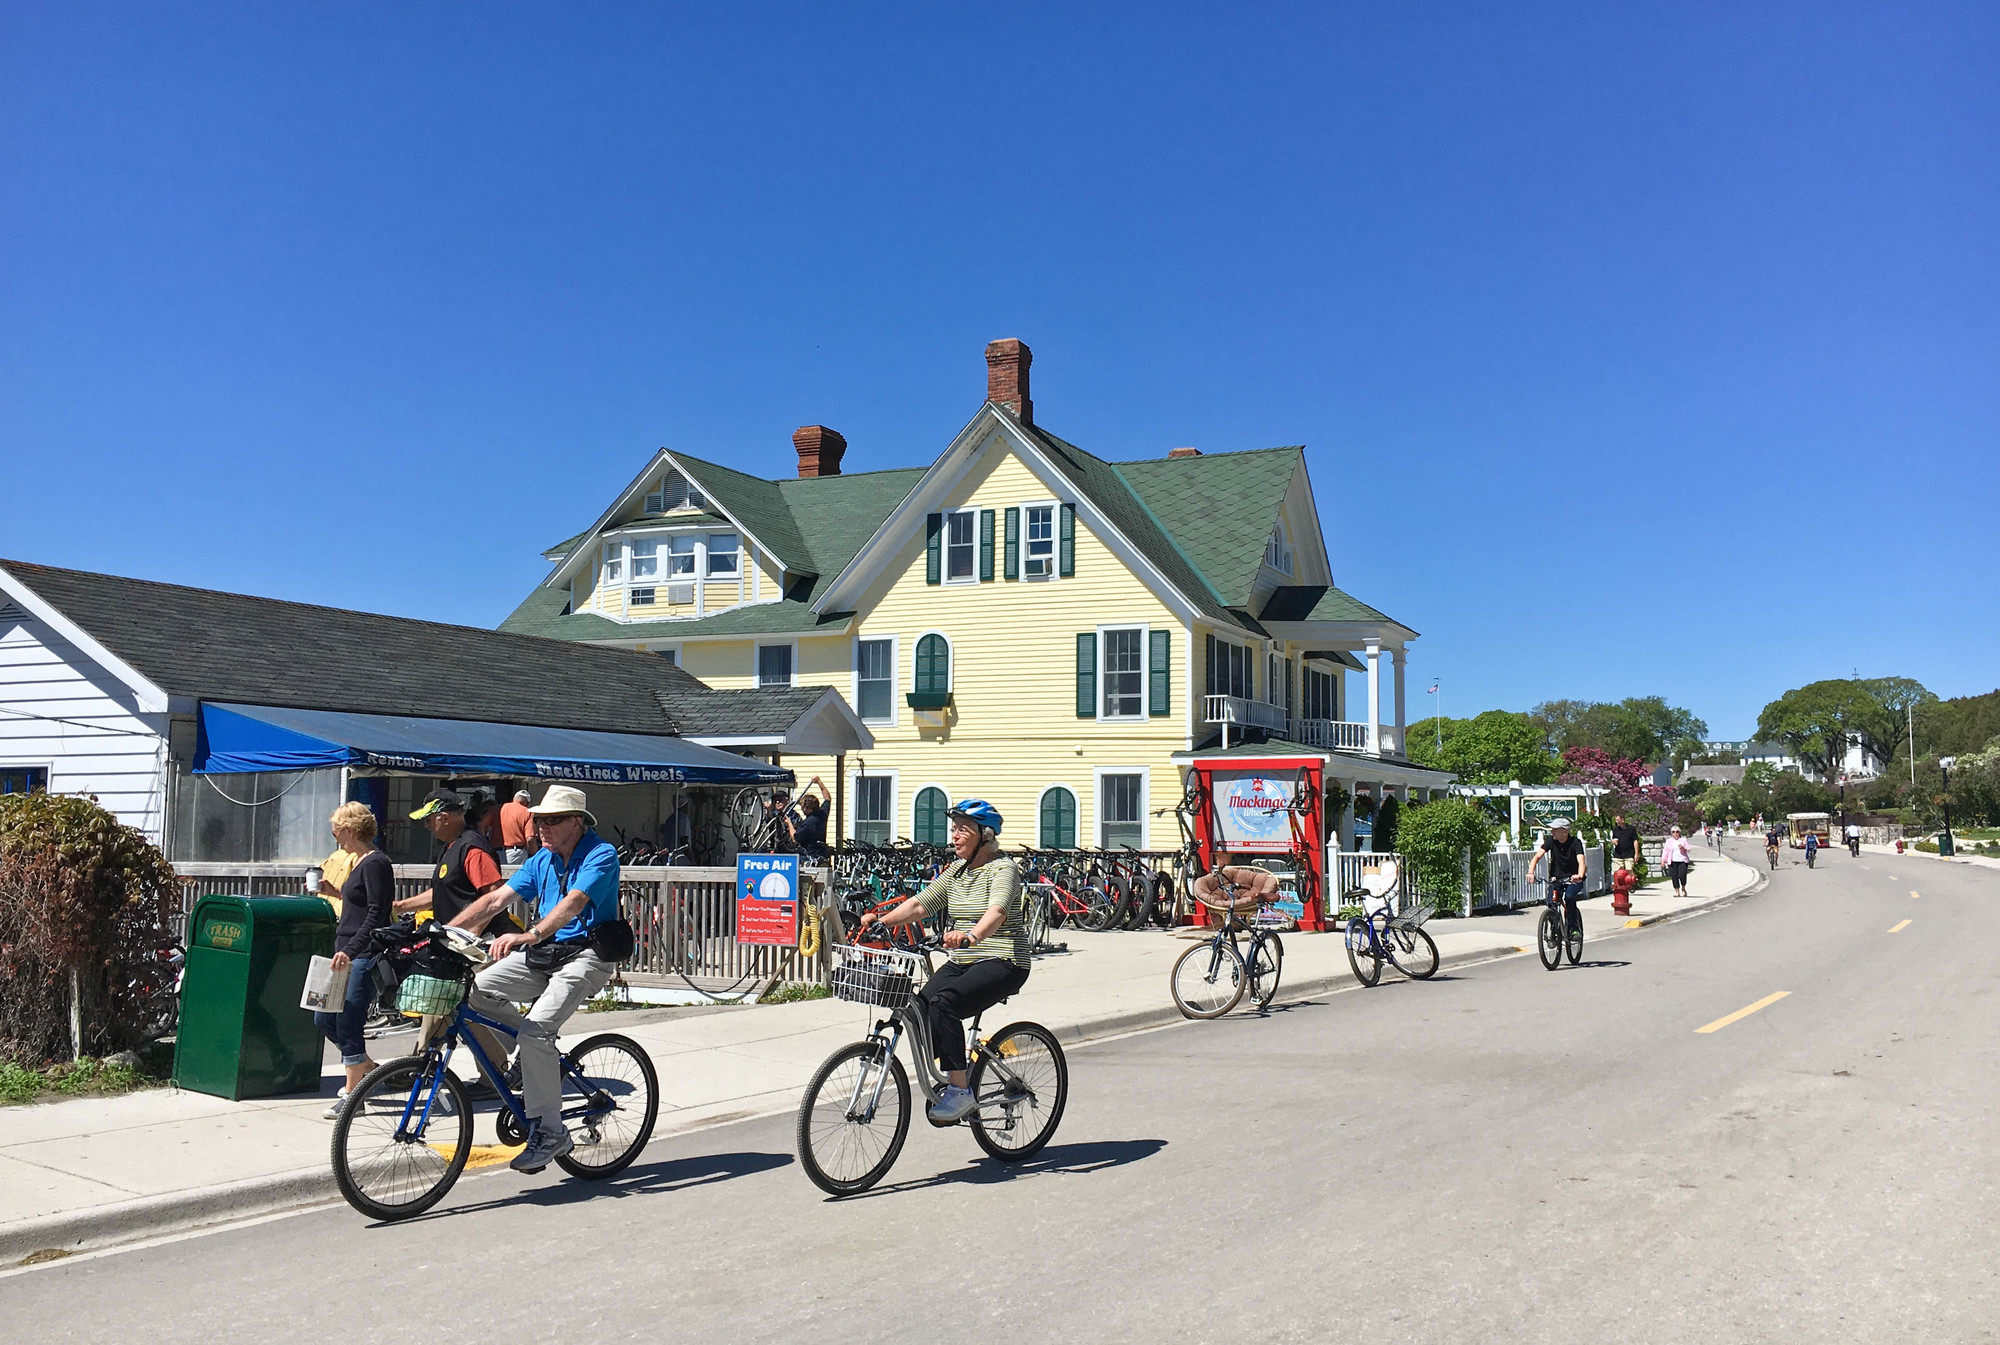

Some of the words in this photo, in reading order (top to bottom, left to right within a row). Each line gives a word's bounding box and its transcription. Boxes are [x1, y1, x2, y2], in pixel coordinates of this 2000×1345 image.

[367, 752, 425, 768] Rentals
[534, 761, 621, 780] Mackinac
[626, 766, 685, 781] Wheels
[1229, 795, 1287, 808] Mackinac
[1524, 800, 1551, 814] Bay
[1548, 800, 1573, 812] View
[744, 859, 769, 870] Free
[771, 859, 792, 871] Air
[741, 914, 745, 922] 2
[210, 925, 241, 938] TRASH
